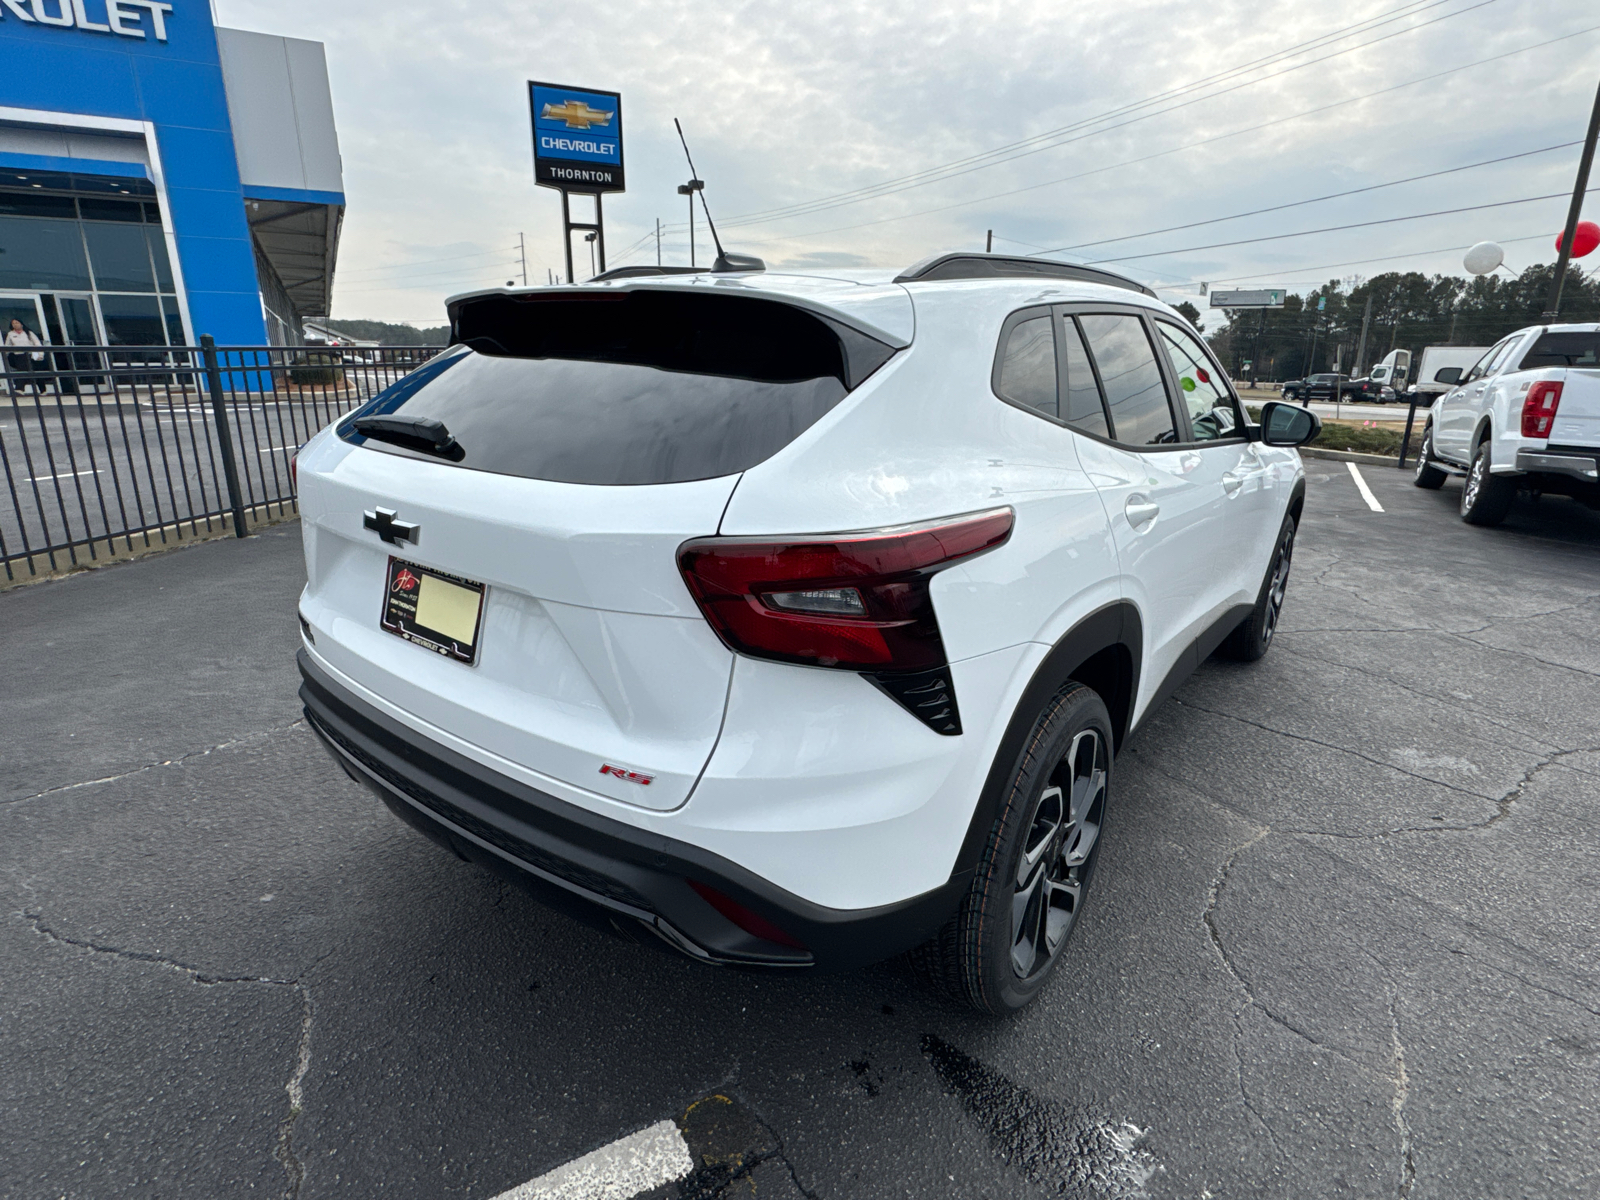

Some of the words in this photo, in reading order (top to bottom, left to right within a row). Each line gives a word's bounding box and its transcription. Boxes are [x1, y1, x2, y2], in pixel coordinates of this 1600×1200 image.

[541, 136, 616, 155] CHEVROLET
[550, 167, 612, 182] THORNTON
[411, 635, 439, 652] CHEVROLET
[599, 763, 656, 785] RS
